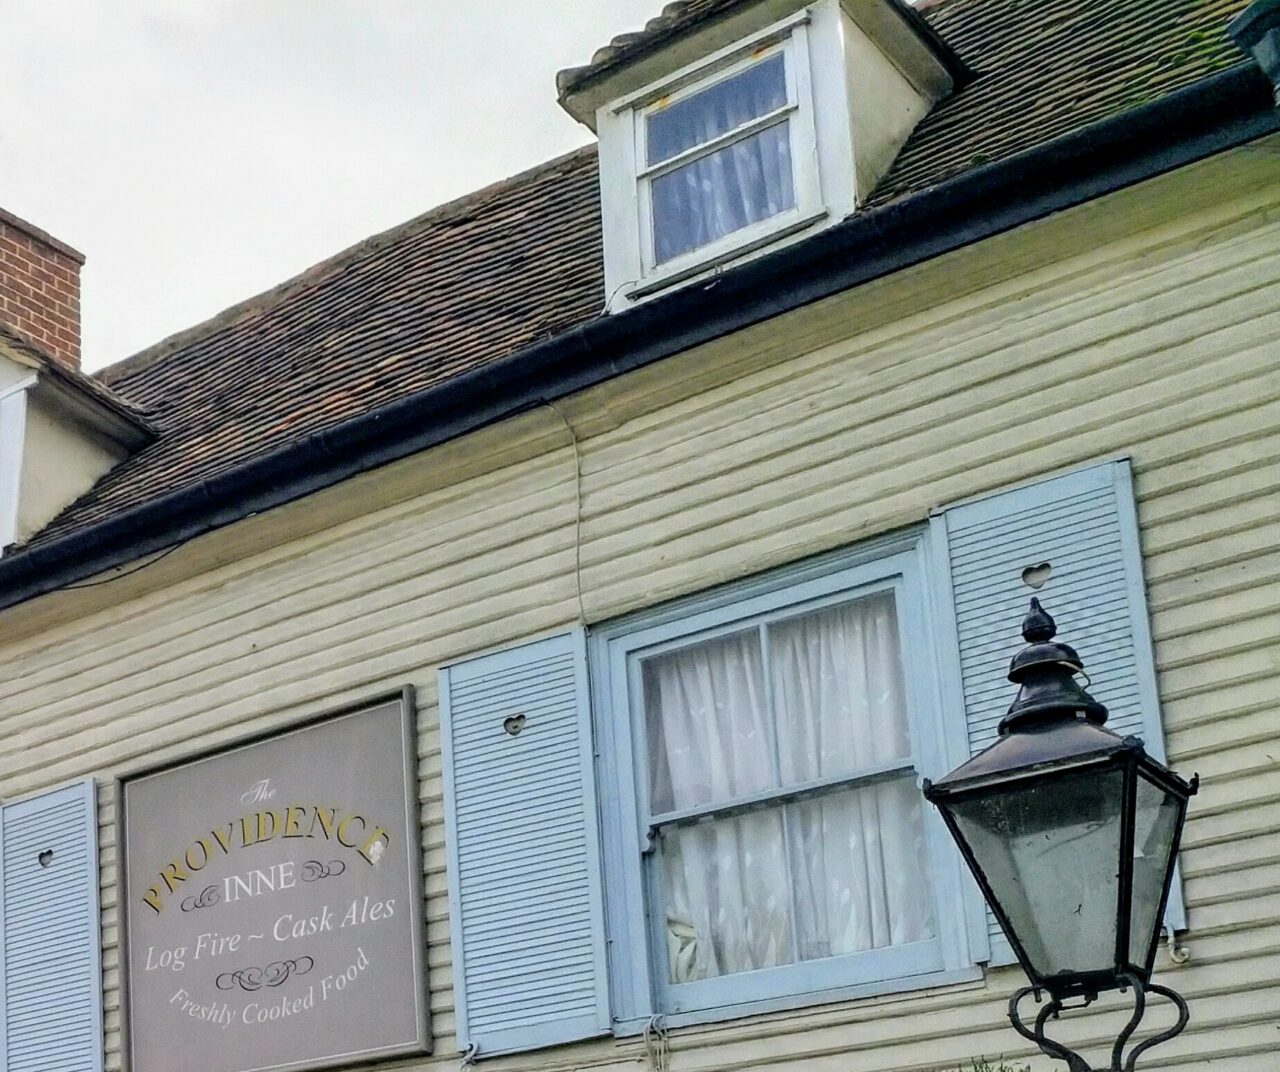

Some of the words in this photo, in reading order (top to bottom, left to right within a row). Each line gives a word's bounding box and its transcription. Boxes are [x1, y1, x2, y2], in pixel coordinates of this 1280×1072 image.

[240, 778, 276, 805] The
[222, 861, 296, 902] INNE
[145, 945, 186, 971] Log
[193, 932, 241, 960] Fire
[272, 905, 333, 941] Cask
[340, 896, 396, 926] Ales
[170, 988, 236, 1028] Freshly
[242, 987, 314, 1024] Cooked
[320, 947, 370, 1000] Food
